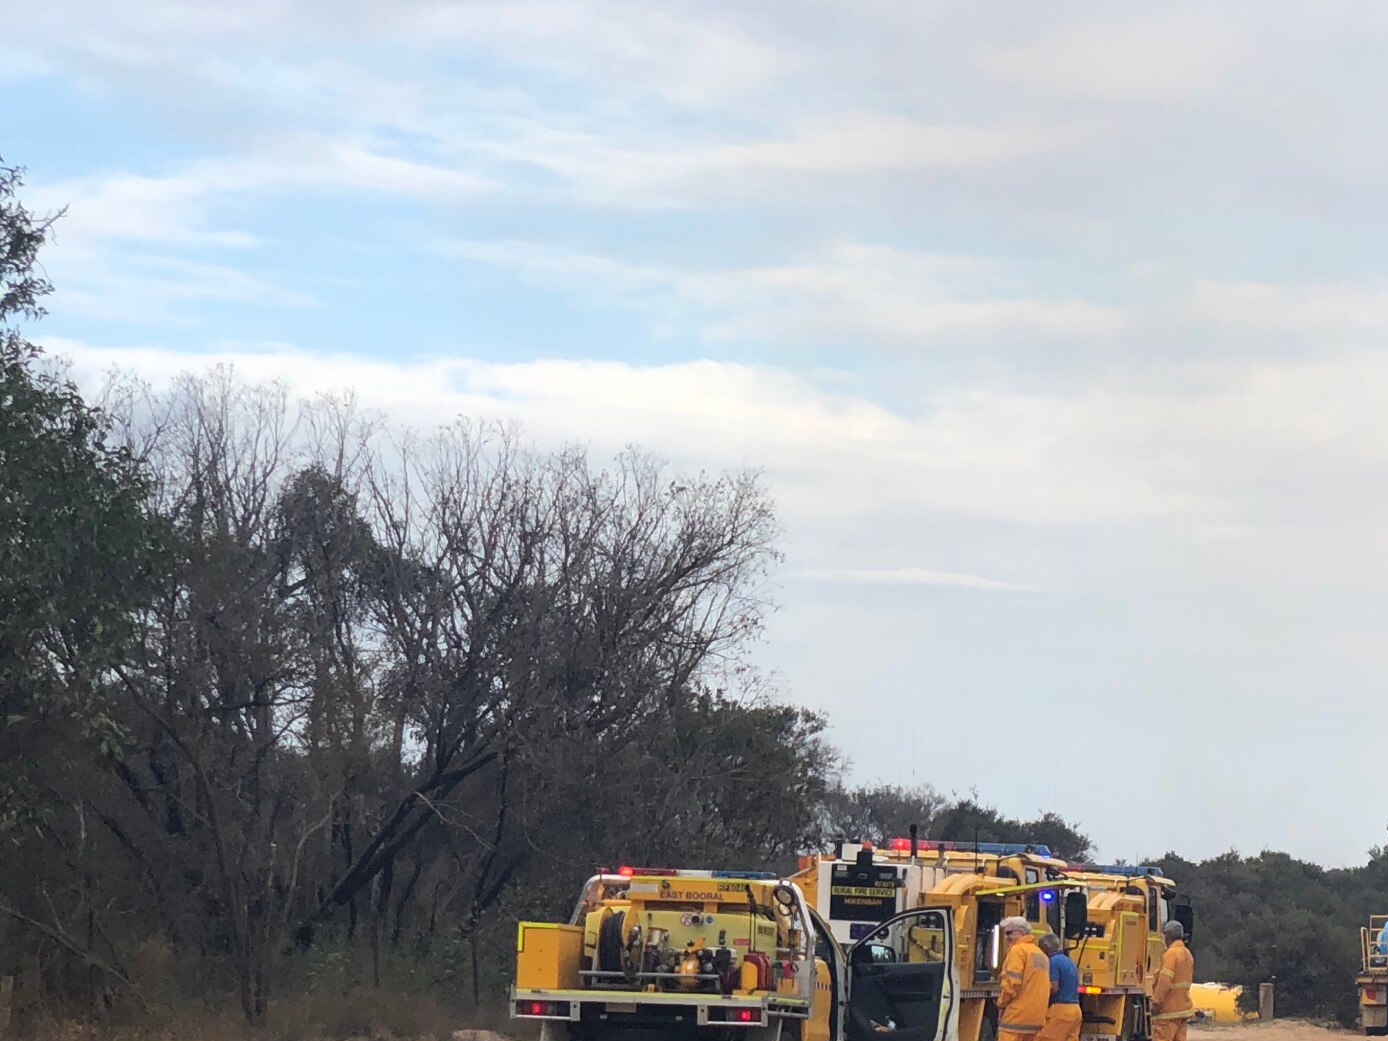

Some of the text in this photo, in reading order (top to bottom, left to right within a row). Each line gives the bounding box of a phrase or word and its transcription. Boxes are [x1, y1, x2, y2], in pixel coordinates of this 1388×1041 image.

[660, 890, 724, 900] EAST BOORAL
[833, 887, 893, 897] RURAL FIRE SERVICE
